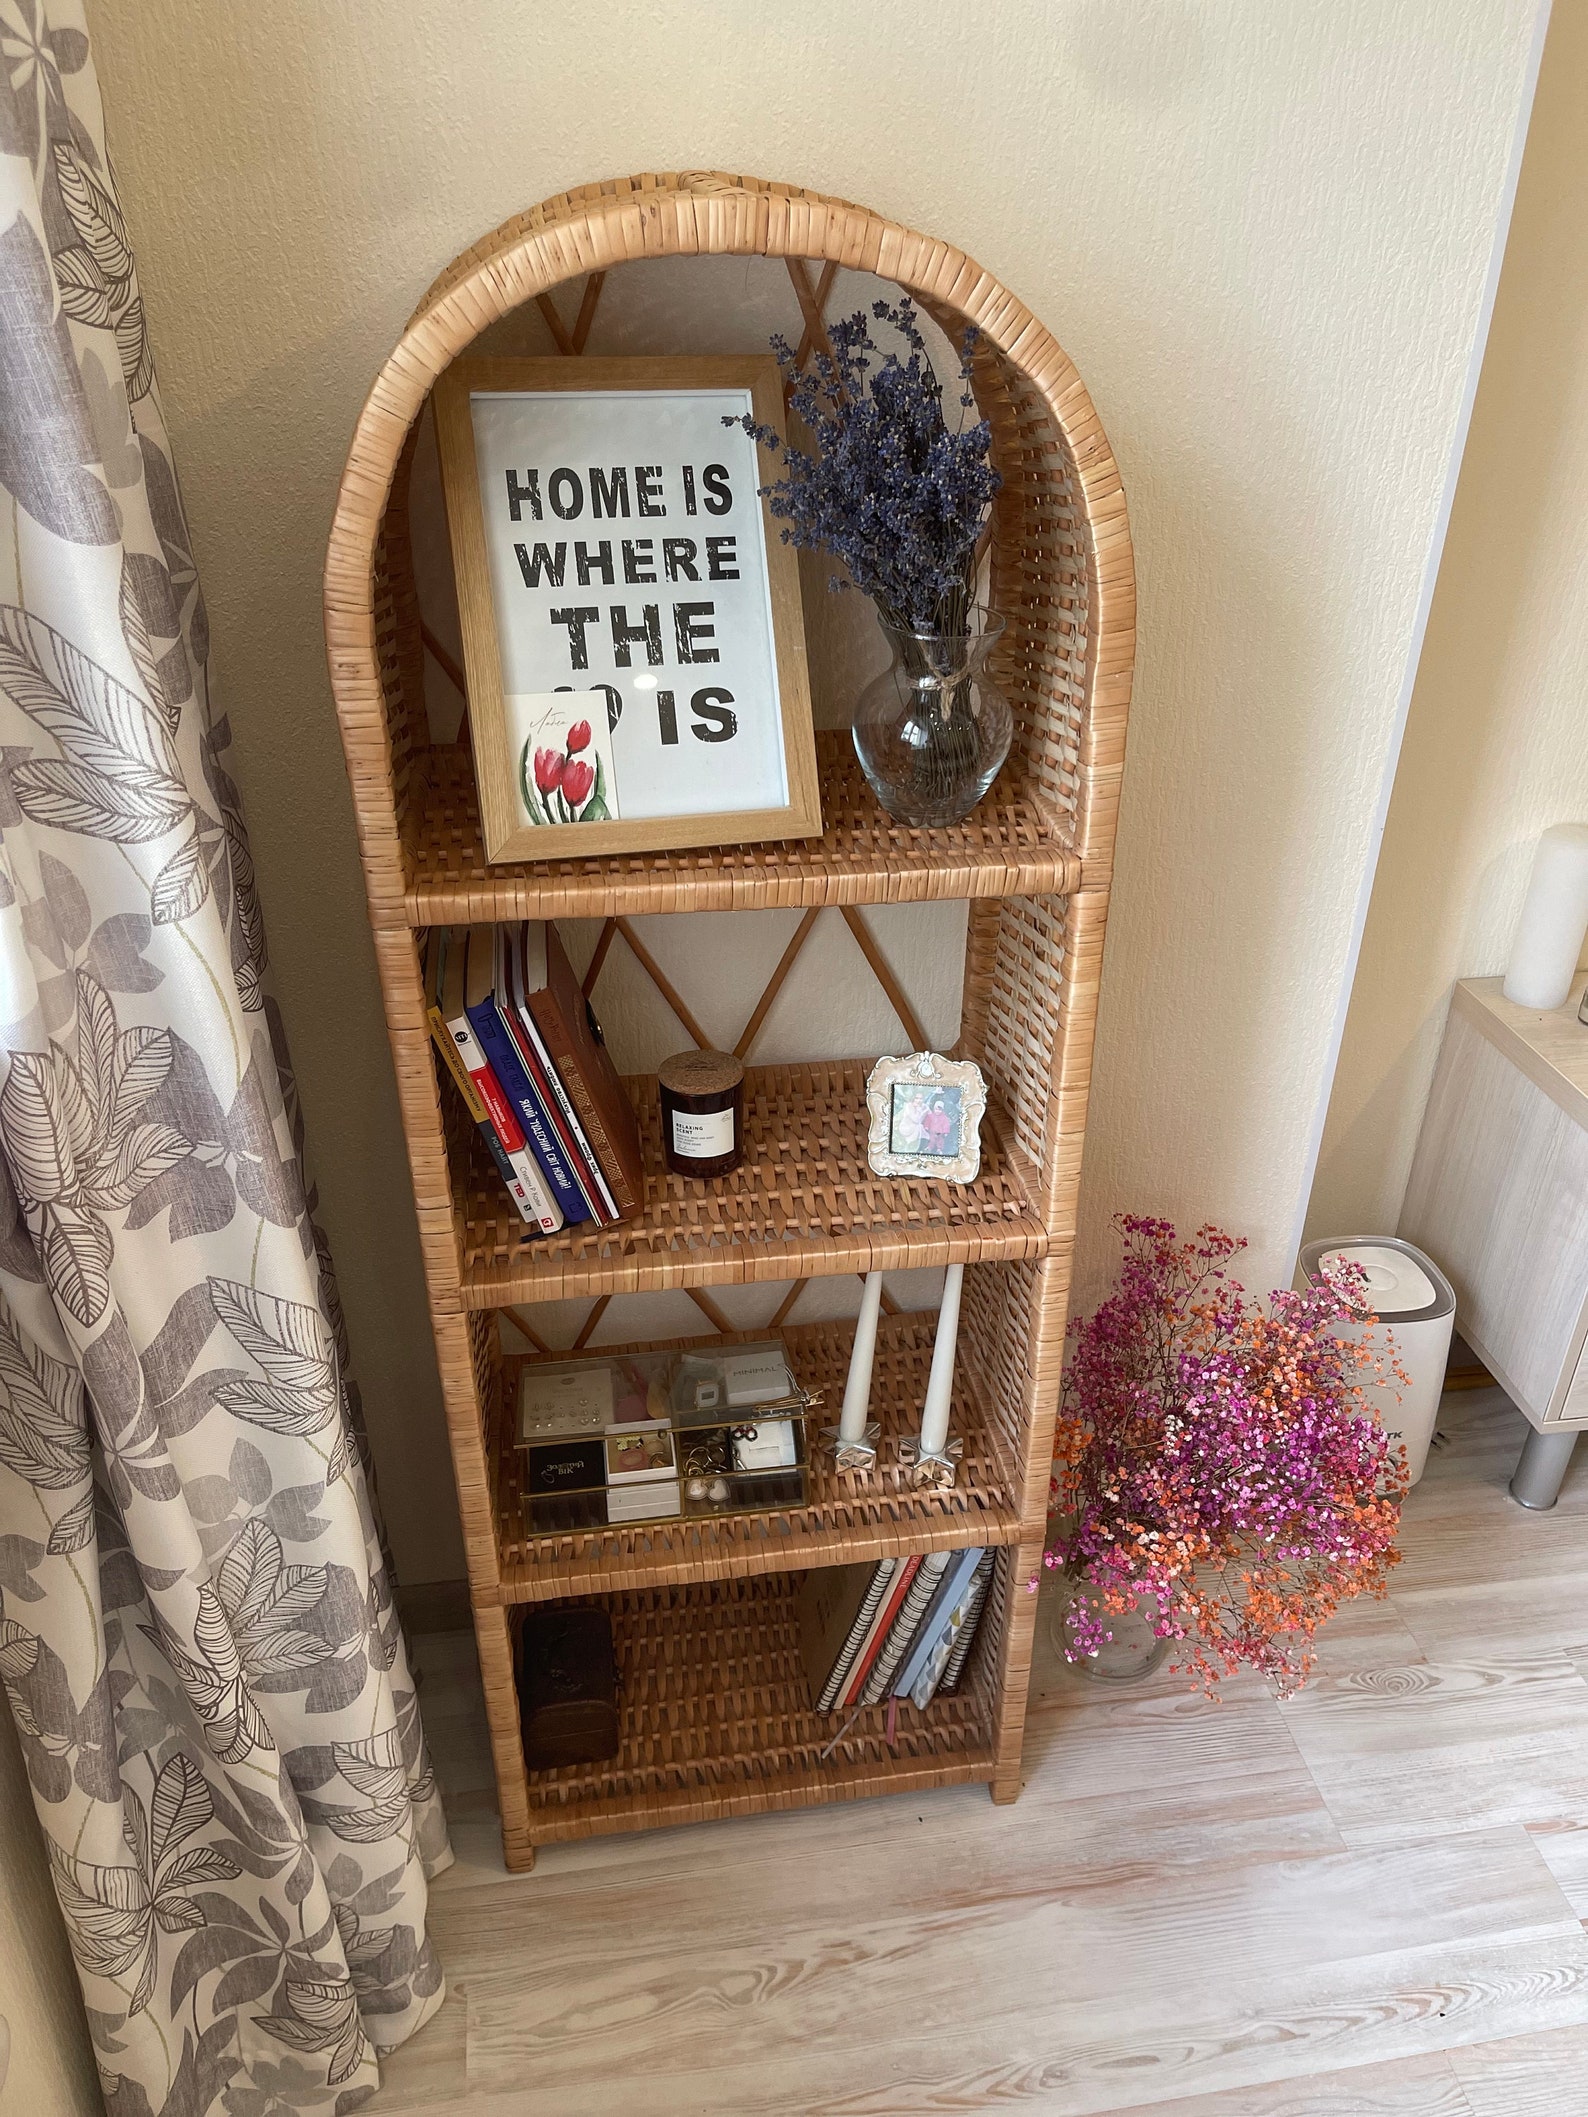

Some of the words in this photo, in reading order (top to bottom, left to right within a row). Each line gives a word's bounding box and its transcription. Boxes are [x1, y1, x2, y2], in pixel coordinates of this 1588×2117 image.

[505, 465, 667, 522] HOME
[682, 463, 733, 517] IS
[513, 536, 741, 588] WHERE
[550, 601, 721, 670] THE
[657, 687, 739, 745] IS
[518, 1096, 538, 1119] ЯКИЙ
[528, 1117, 554, 1154] ЧУДЕСНИЙ
[545, 1150, 560, 1167] СВІТ
[675, 1122, 704, 1131] RELAXING
[676, 1127, 693, 1135] SCENT
[513, 1182, 525, 1198] TED
[733, 1366, 777, 1376] MINIMAL
[900, 1556, 920, 1587] DEADLINE
